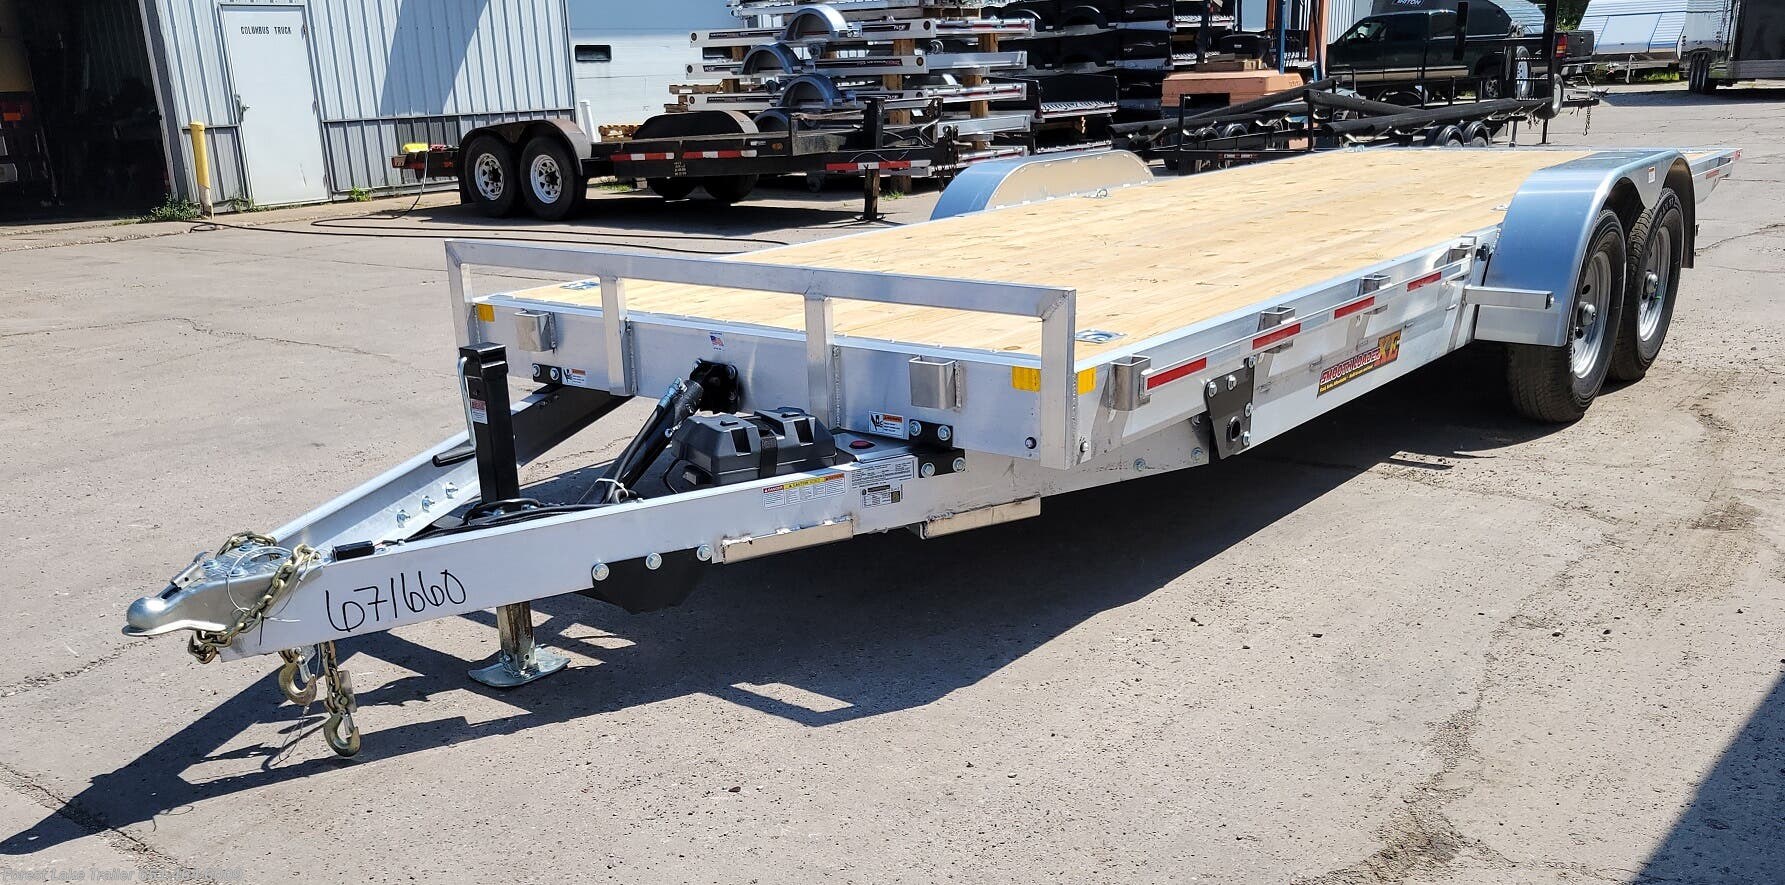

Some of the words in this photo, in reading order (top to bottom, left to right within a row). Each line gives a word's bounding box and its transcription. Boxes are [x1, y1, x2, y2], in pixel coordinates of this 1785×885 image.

[240, 26, 270, 35] COLUMBUS
[273, 26, 292, 35] TRUCK
[325, 569, 467, 633] 671660
